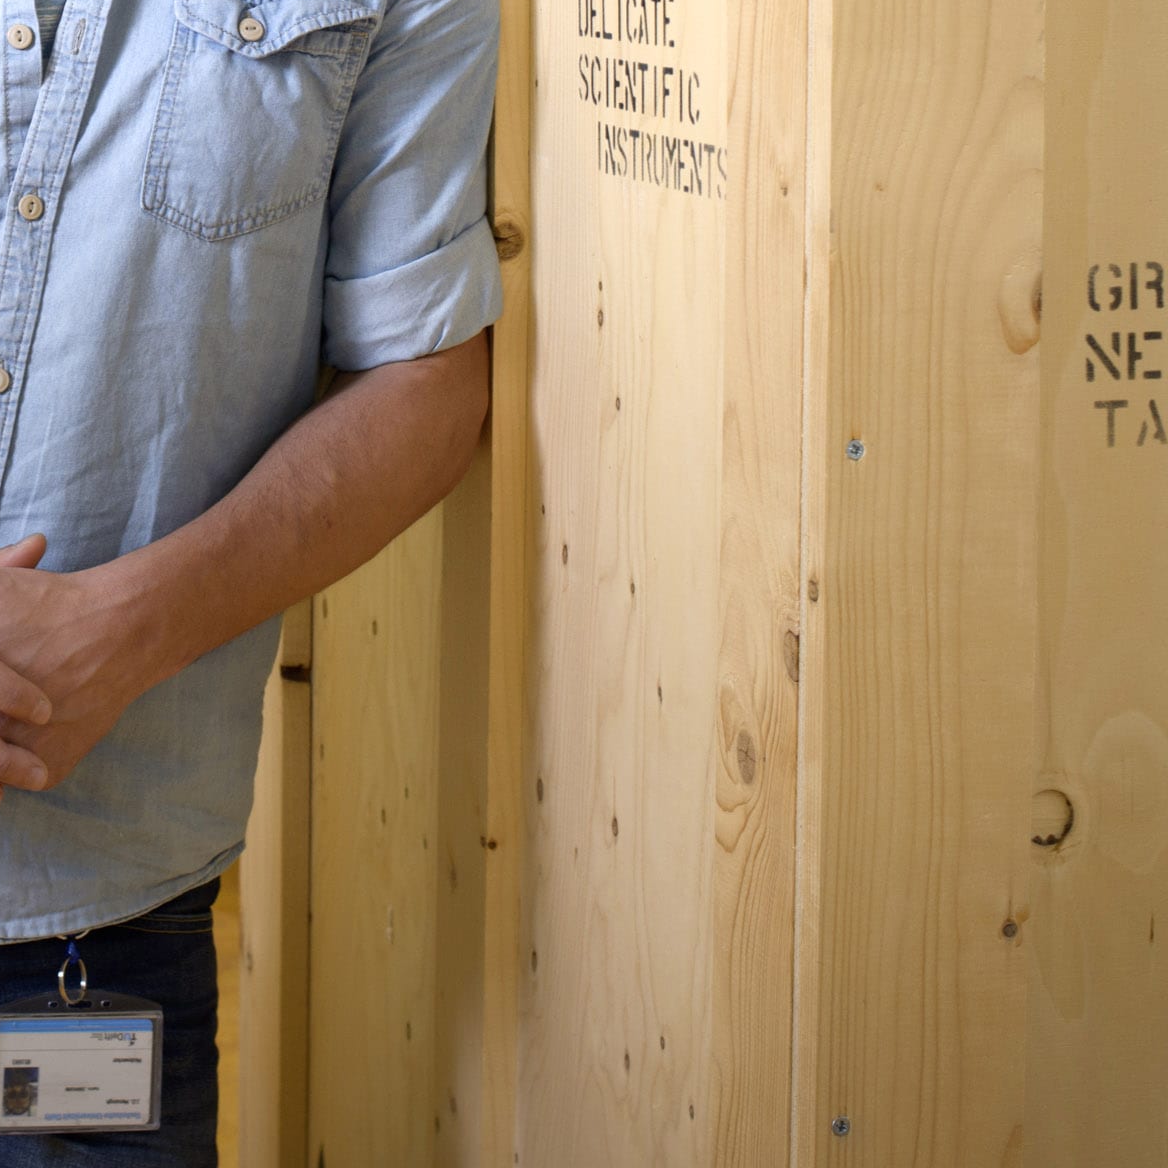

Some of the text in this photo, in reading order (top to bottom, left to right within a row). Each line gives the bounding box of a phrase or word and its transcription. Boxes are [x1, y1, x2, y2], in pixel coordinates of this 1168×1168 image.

[578, 54, 700, 125] SCIENTIFIC
[597, 121, 727, 200] INSTRUMENTS
[1087, 261, 1165, 312] GR
[1085, 331, 1163, 382] NE
[1093, 398, 1168, 448] TA
